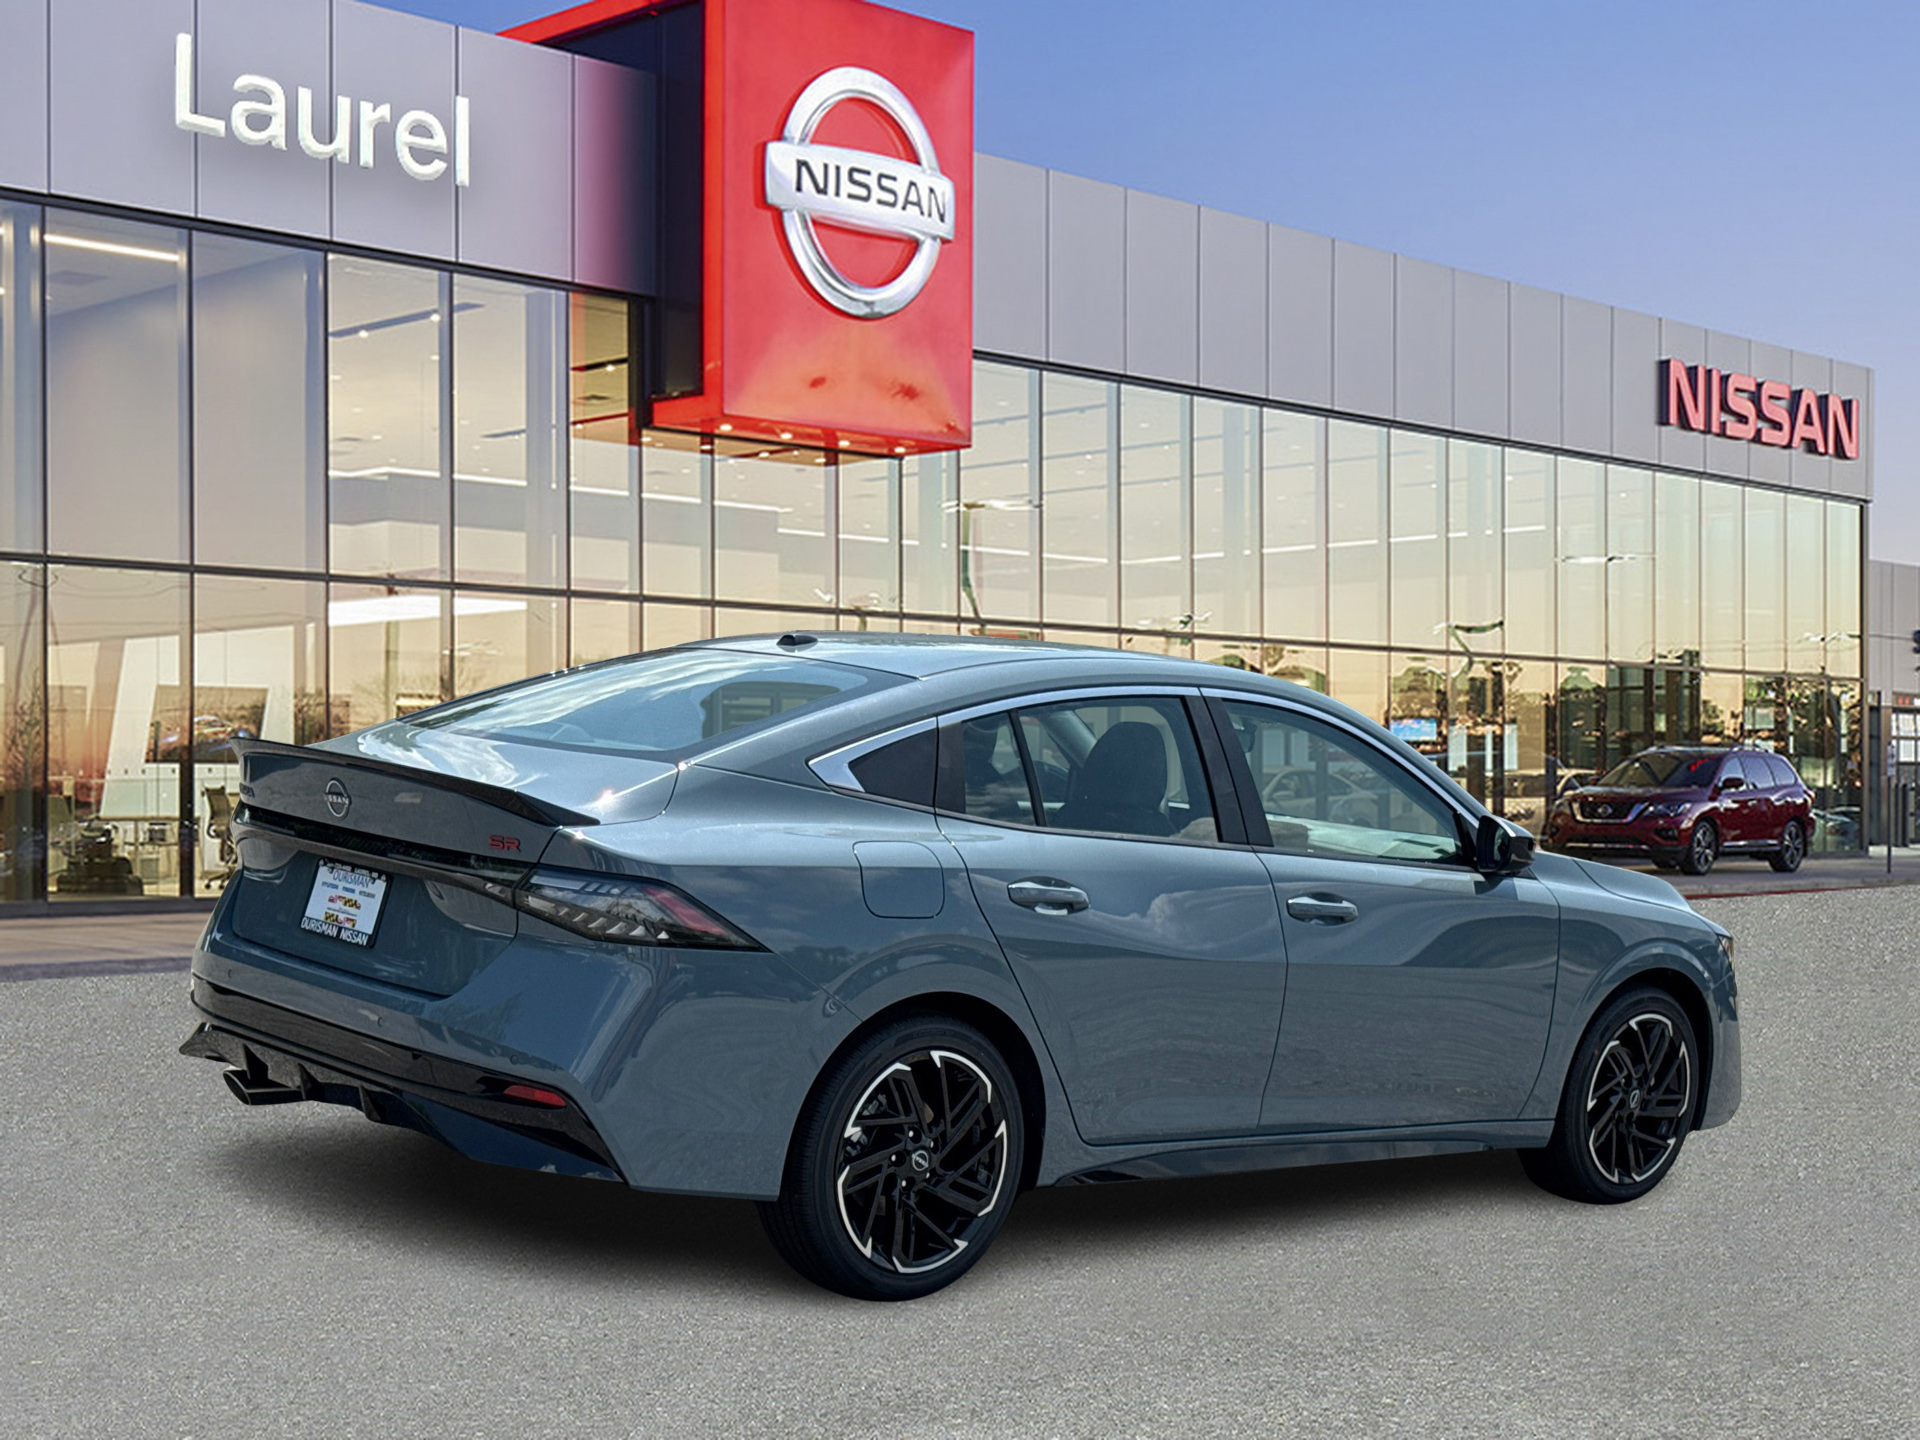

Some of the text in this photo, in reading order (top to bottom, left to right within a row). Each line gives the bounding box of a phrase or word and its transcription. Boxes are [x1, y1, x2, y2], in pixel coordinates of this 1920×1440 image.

[174, 32, 470, 187] Laurel
[795, 159, 946, 223] NISSAN
[1657, 358, 1860, 460] NISSAN
[488, 835, 520, 852] SR
[333, 870, 371, 888] OURISMAN
[301, 917, 369, 946] OURISMAN NISSAN
